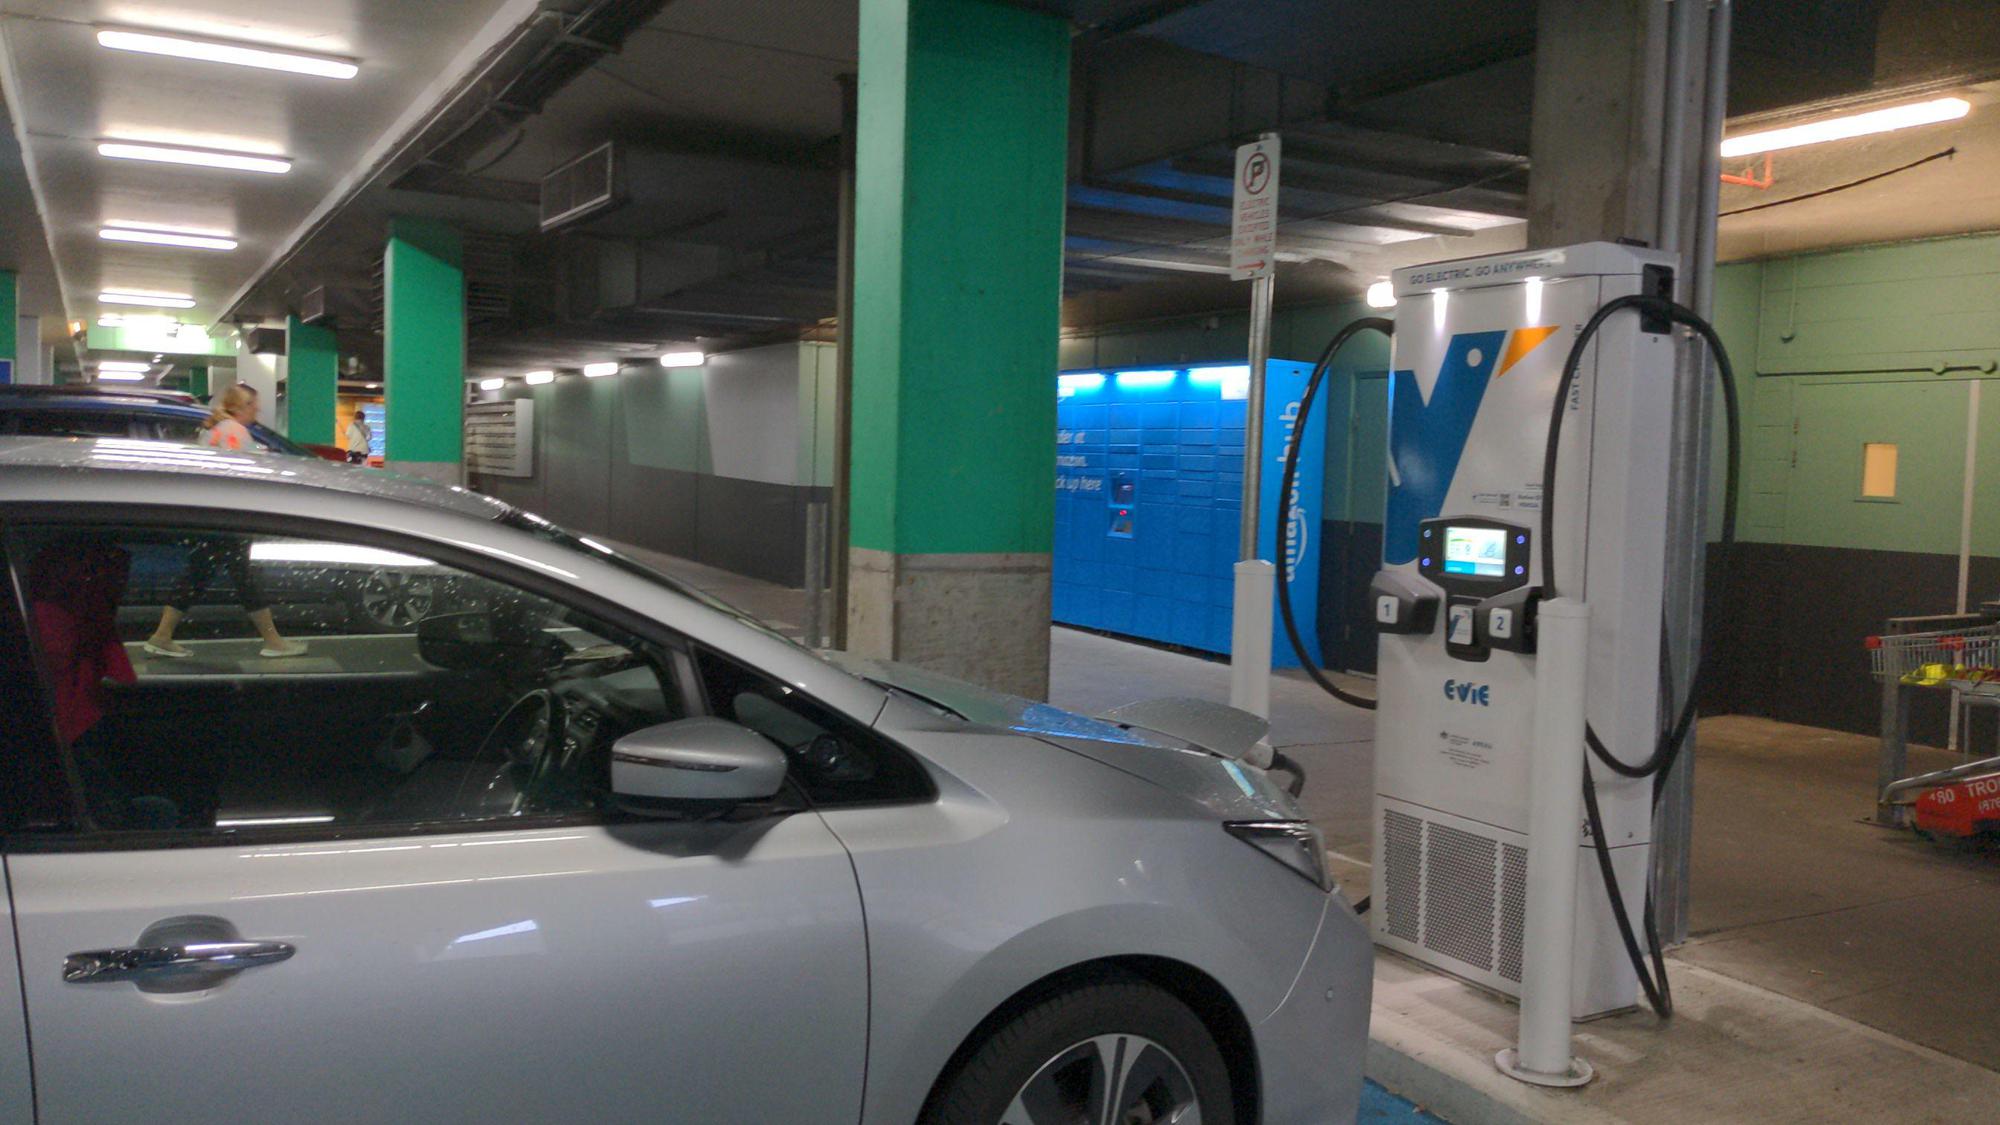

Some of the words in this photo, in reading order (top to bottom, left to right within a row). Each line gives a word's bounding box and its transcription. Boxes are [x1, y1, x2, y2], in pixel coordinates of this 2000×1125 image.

[1410, 273, 1424, 284] GO
[1477, 265, 1489, 277] GO
[1056, 455, 1088, 467] mazon.
[1080, 476, 1102, 491] here
[1496, 616, 1504, 631] 2
[1965, 779, 2000, 798] TRO
